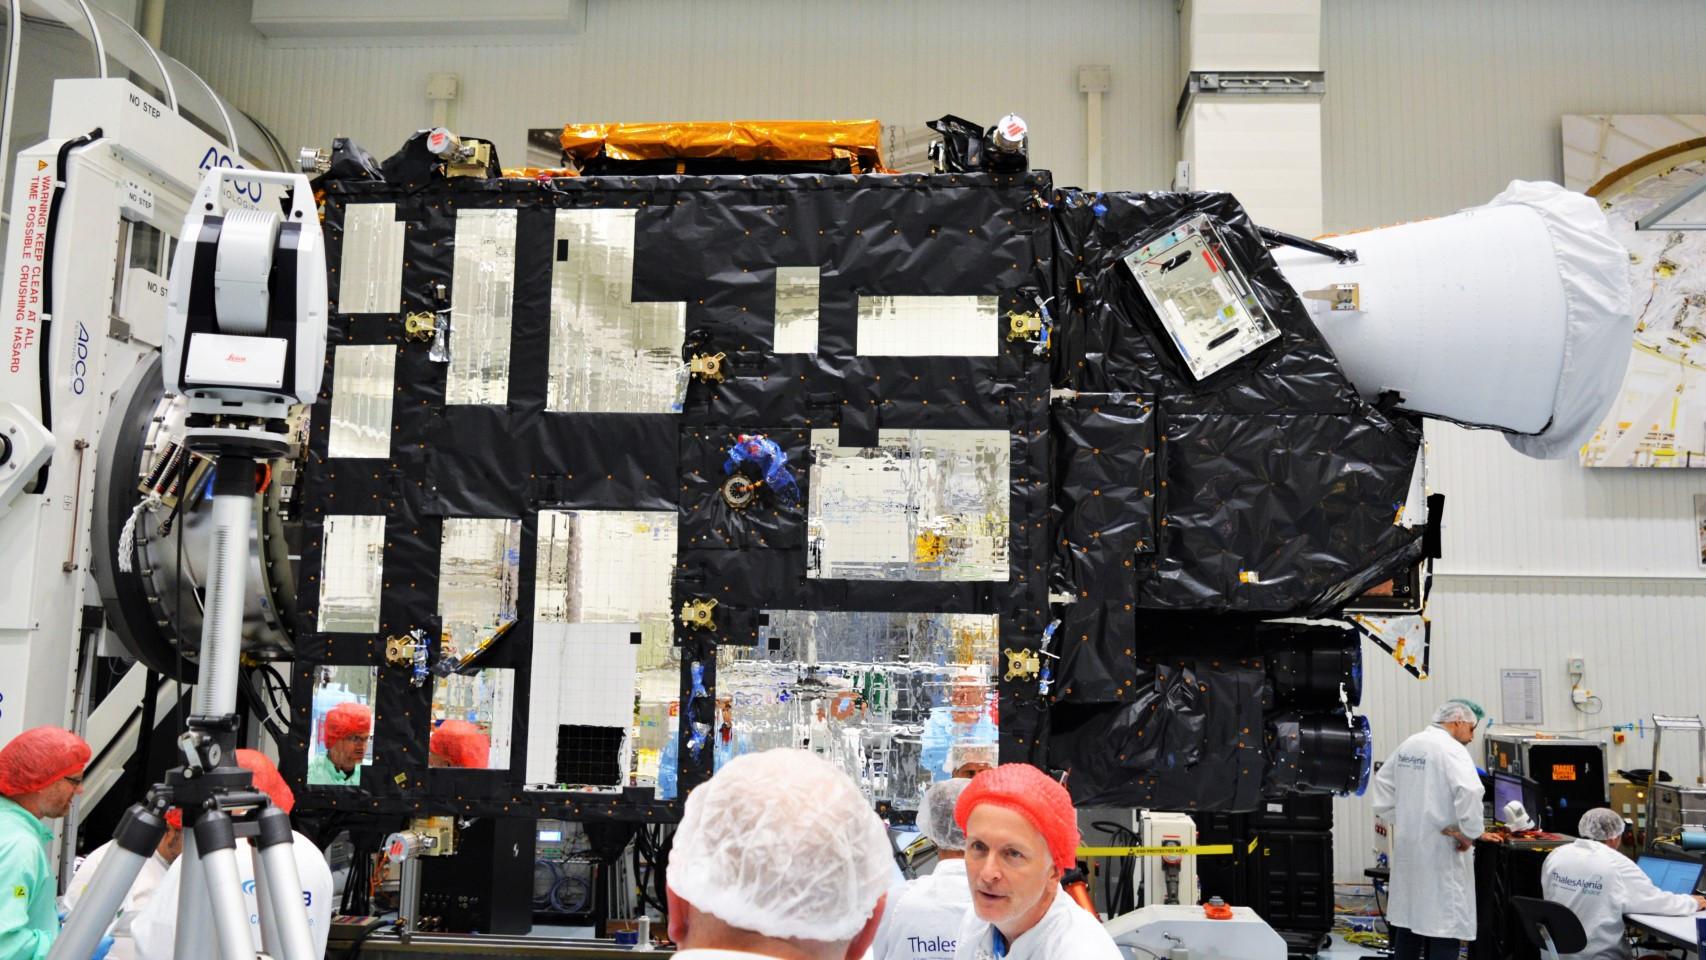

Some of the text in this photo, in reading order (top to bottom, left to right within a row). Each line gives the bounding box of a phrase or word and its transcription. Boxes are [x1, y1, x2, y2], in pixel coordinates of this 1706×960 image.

[130, 93, 161, 119] NO STEP
[129, 192, 152, 209] NO STEP
[10, 175, 39, 373] TIME POSSIBLE CRUSHING HASARD
[24, 175, 51, 349] WARNING! KEEP CLEAR AT ALL
[147, 281, 158, 293] NO
[73, 321, 89, 395] APCO
[907, 935, 957, 953] Thales
